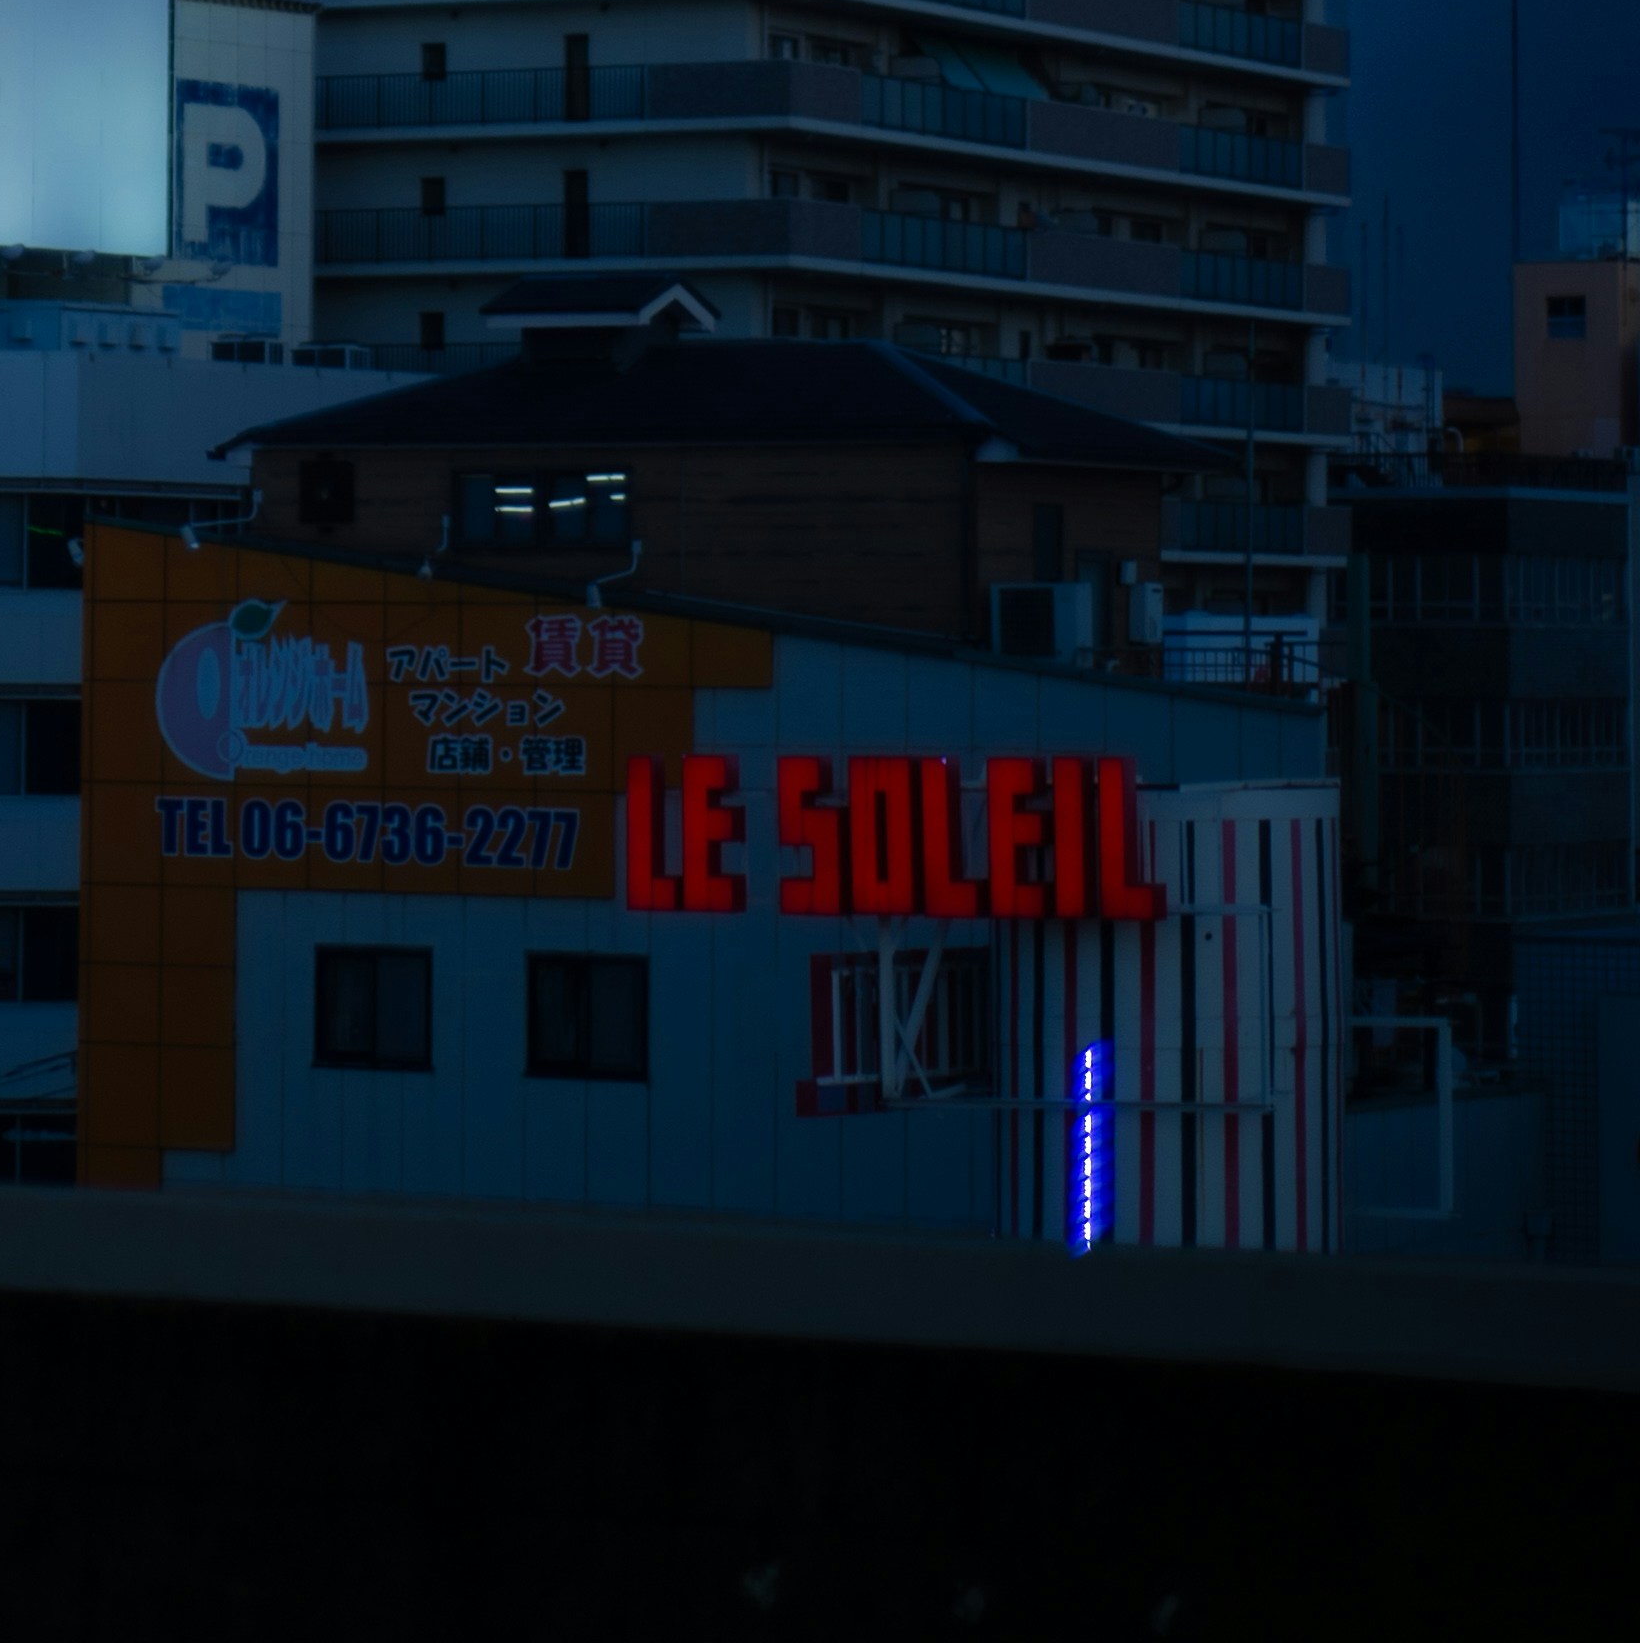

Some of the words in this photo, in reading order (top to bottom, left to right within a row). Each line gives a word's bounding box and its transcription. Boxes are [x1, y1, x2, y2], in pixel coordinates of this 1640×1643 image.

[181, 102, 267, 244] P
[387, 647, 508, 682] アパート
[524, 615, 645, 678] 賃貸
[410, 689, 564, 726] マンション
[157, 799, 231, 856] TEL
[242, 800, 579, 869] 06-6736-2277
[627, 755, 746, 911] LE
[777, 756, 1166, 919] SOLEIL
